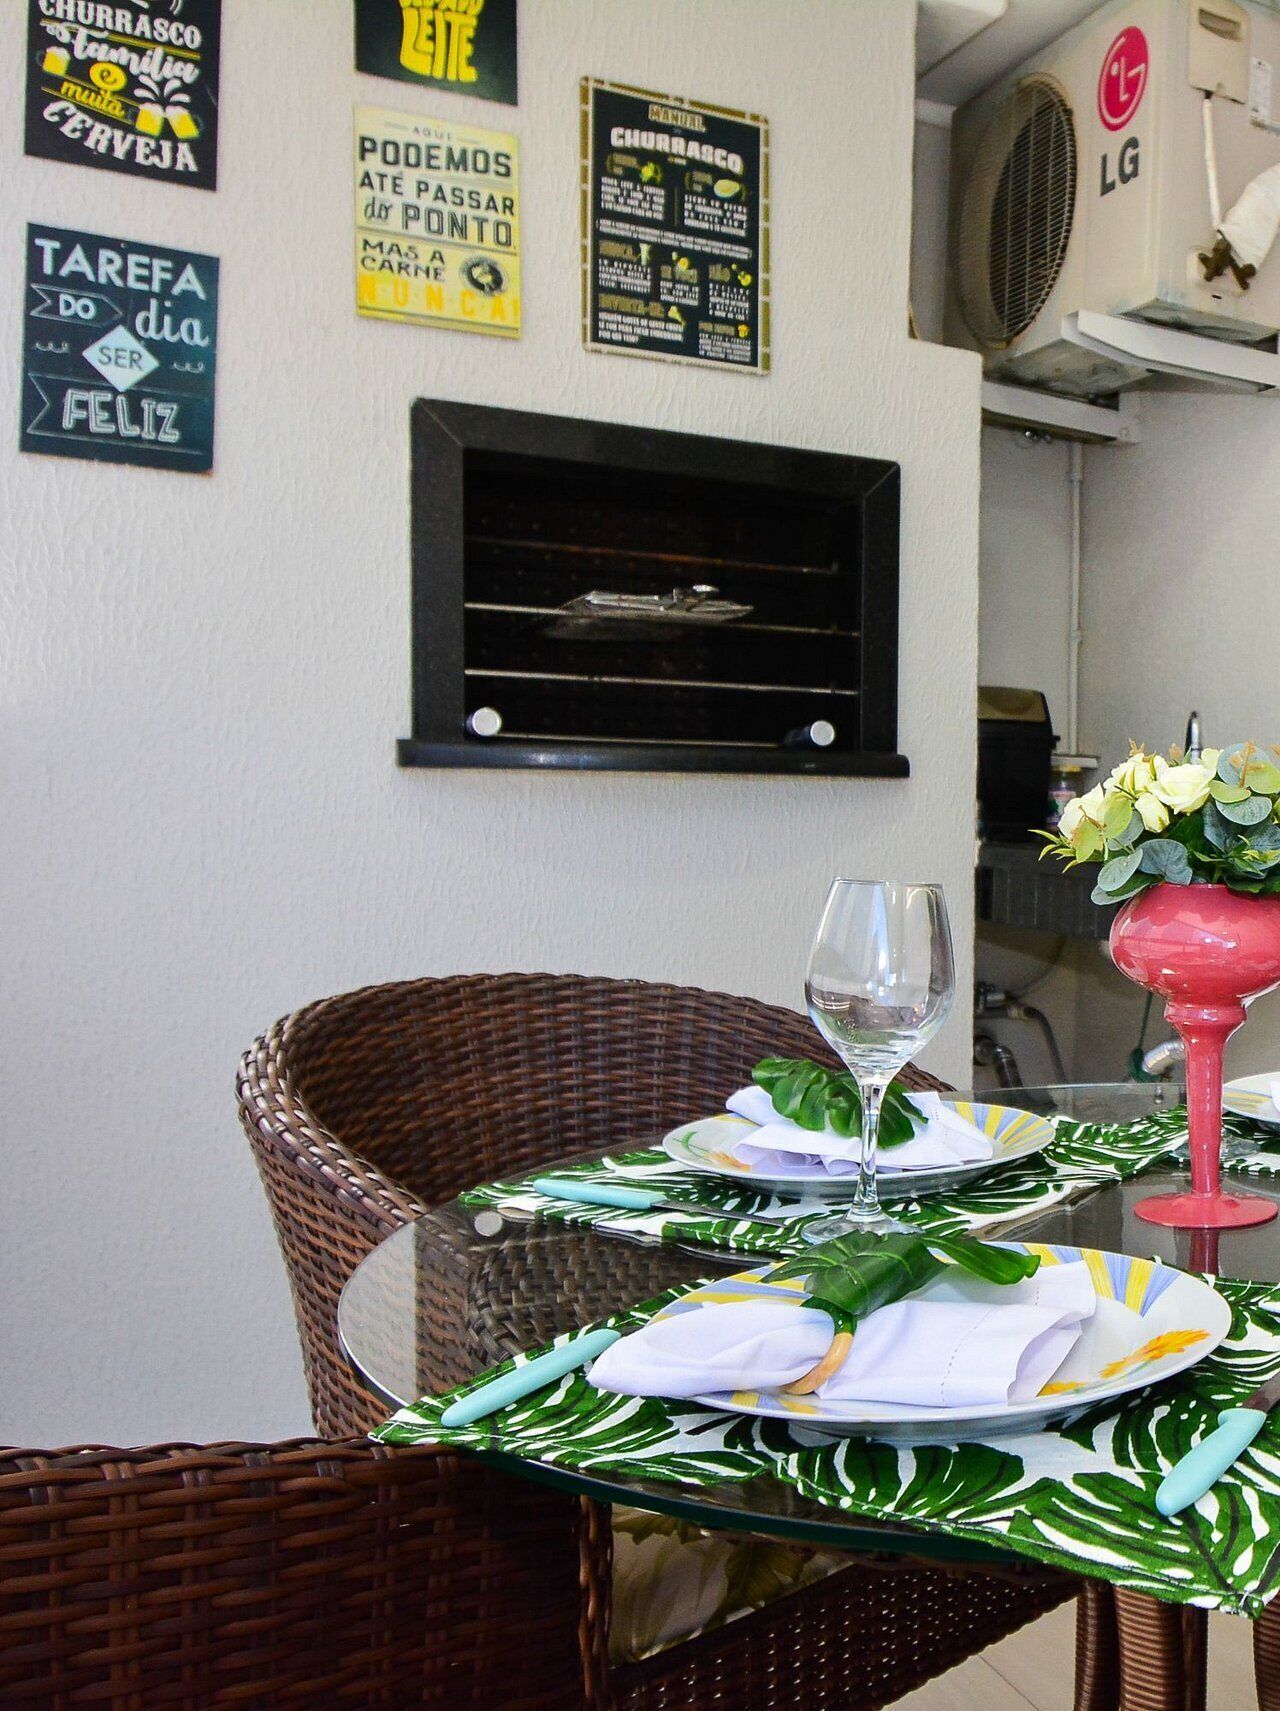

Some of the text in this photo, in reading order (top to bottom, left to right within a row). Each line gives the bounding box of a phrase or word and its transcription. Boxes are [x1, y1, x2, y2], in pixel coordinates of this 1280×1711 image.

[38, 0, 202, 49] CHURRASCO
[400, 7, 478, 82] LEITE
[60, 81, 125, 118] muita
[43, 100, 199, 172] CERVEJA
[358, 135, 511, 178] PODEMOS
[611, 127, 743, 174] CHURRASCO
[1100, 136, 1140, 197] LG
[359, 169, 515, 216] ATÉ PASSAR
[34, 238, 206, 300] TAREFA
[360, 254, 446, 283] CARNE
[362, 238, 445, 265] MAS A
[59, 294, 97, 320] DO
[135, 297, 210, 347] dia
[97, 346, 143, 371] SER
[62, 387, 180, 443] FELIZ
